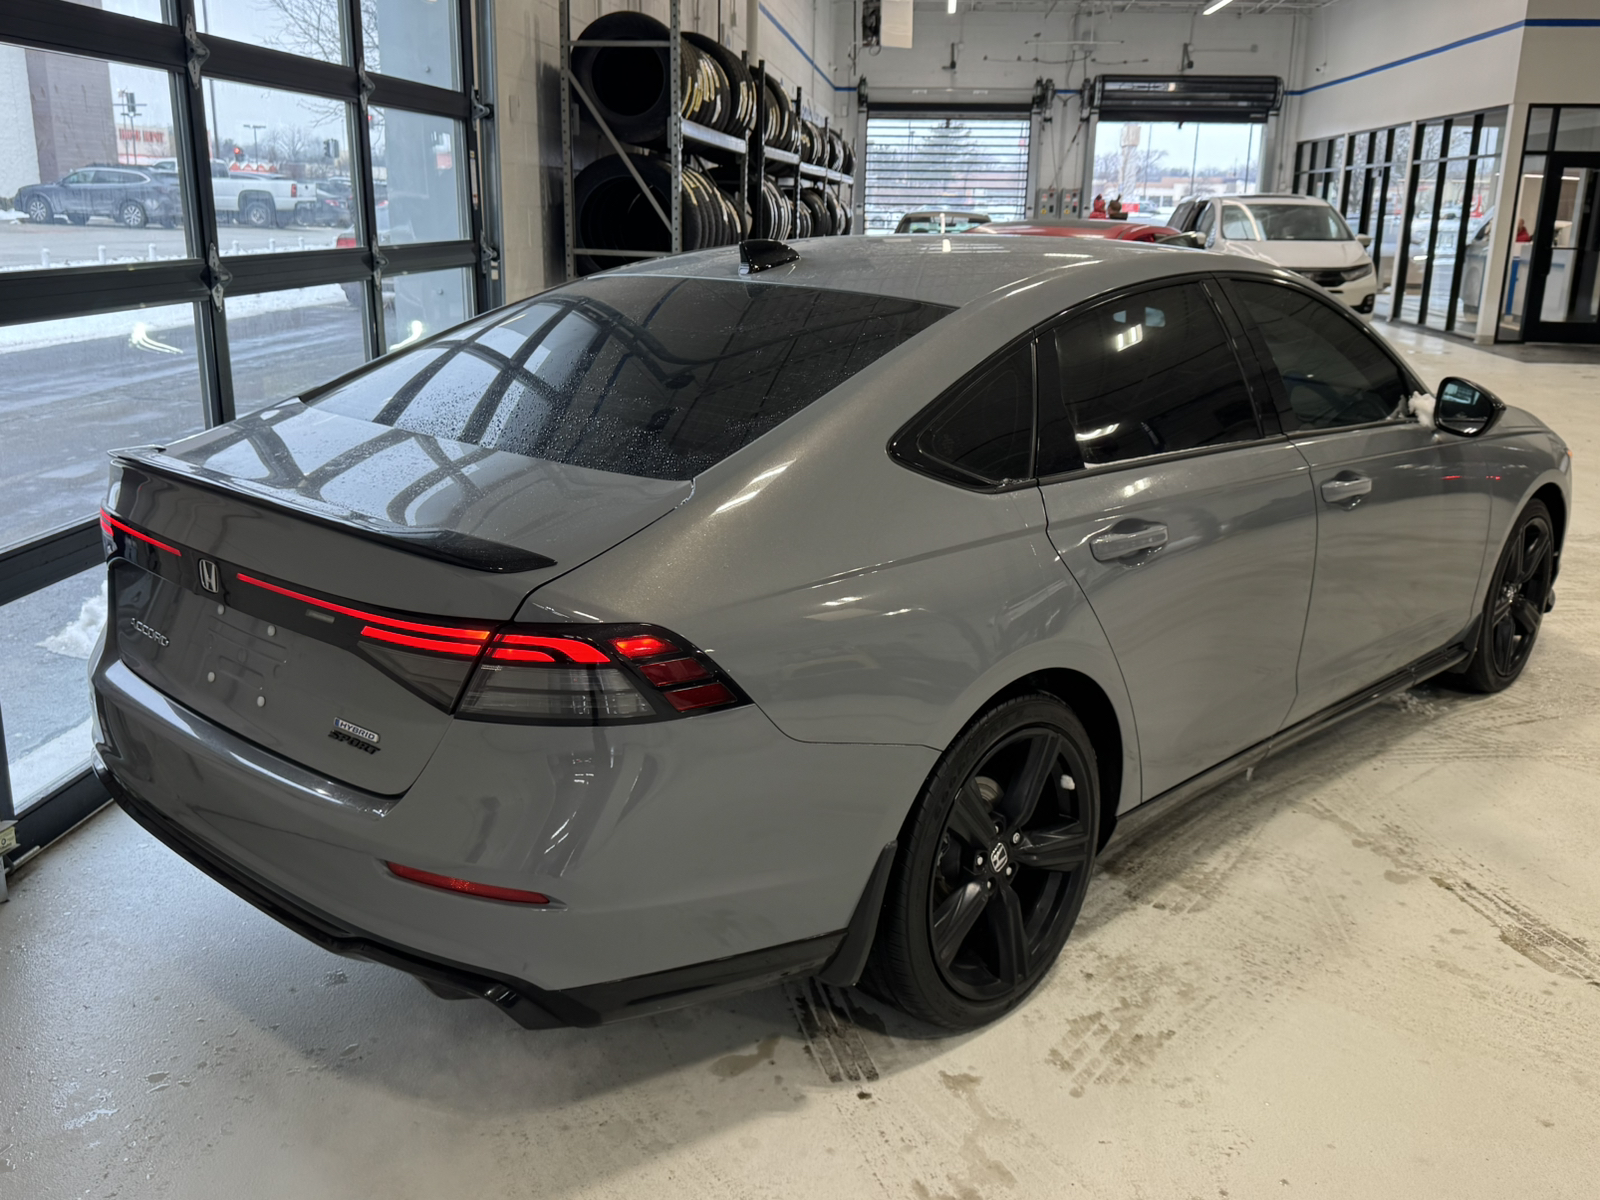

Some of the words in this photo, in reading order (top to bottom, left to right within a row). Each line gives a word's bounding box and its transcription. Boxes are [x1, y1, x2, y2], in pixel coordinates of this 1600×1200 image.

[130, 617, 170, 647] ACCORD
[328, 730, 382, 755] SPORT
[339, 721, 376, 741] HYBRID
